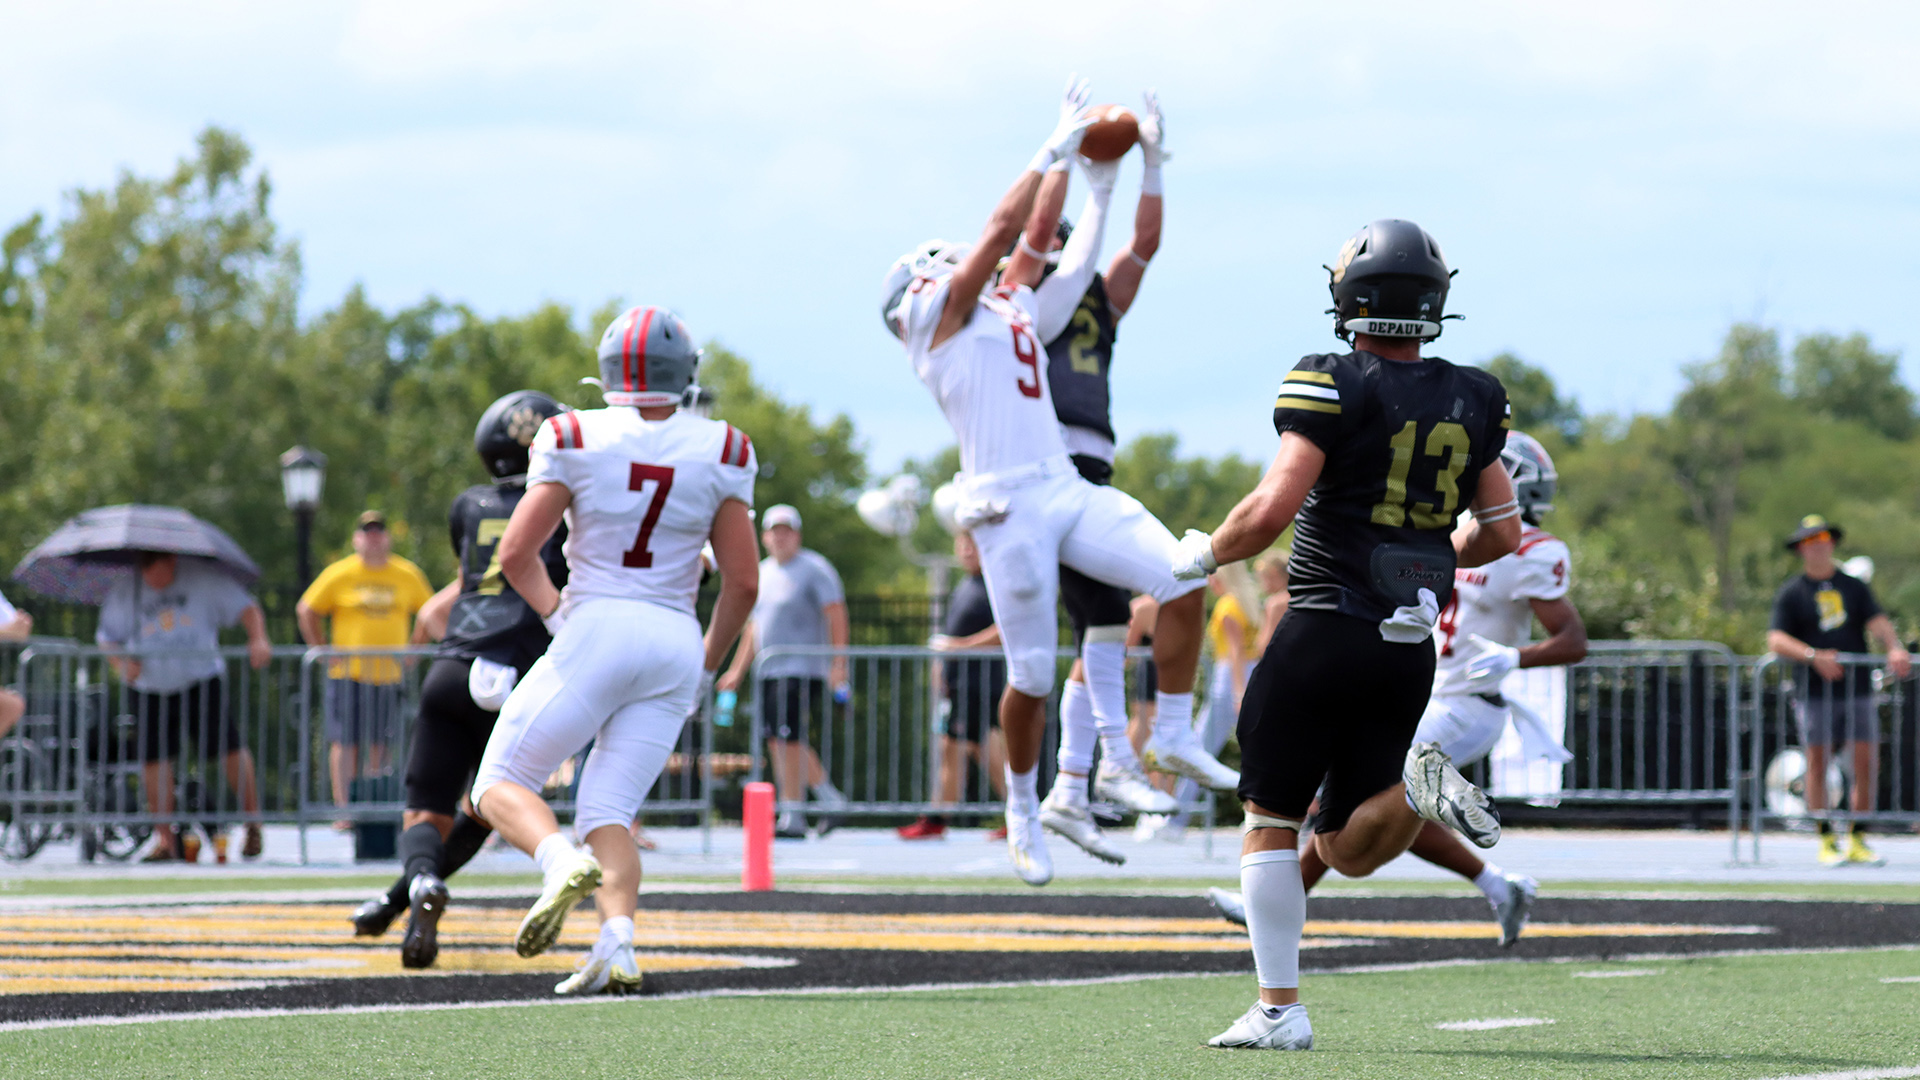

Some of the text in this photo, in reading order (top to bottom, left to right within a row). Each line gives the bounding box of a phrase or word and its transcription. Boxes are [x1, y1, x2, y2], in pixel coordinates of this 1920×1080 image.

[1011, 323, 1042, 399] 9
[1069, 307, 1100, 376] 2
[1368, 321, 1424, 335] DEPAUW
[1370, 420, 1471, 530] 13
[622, 461, 675, 568] 7
[1439, 588, 1458, 656] 4
